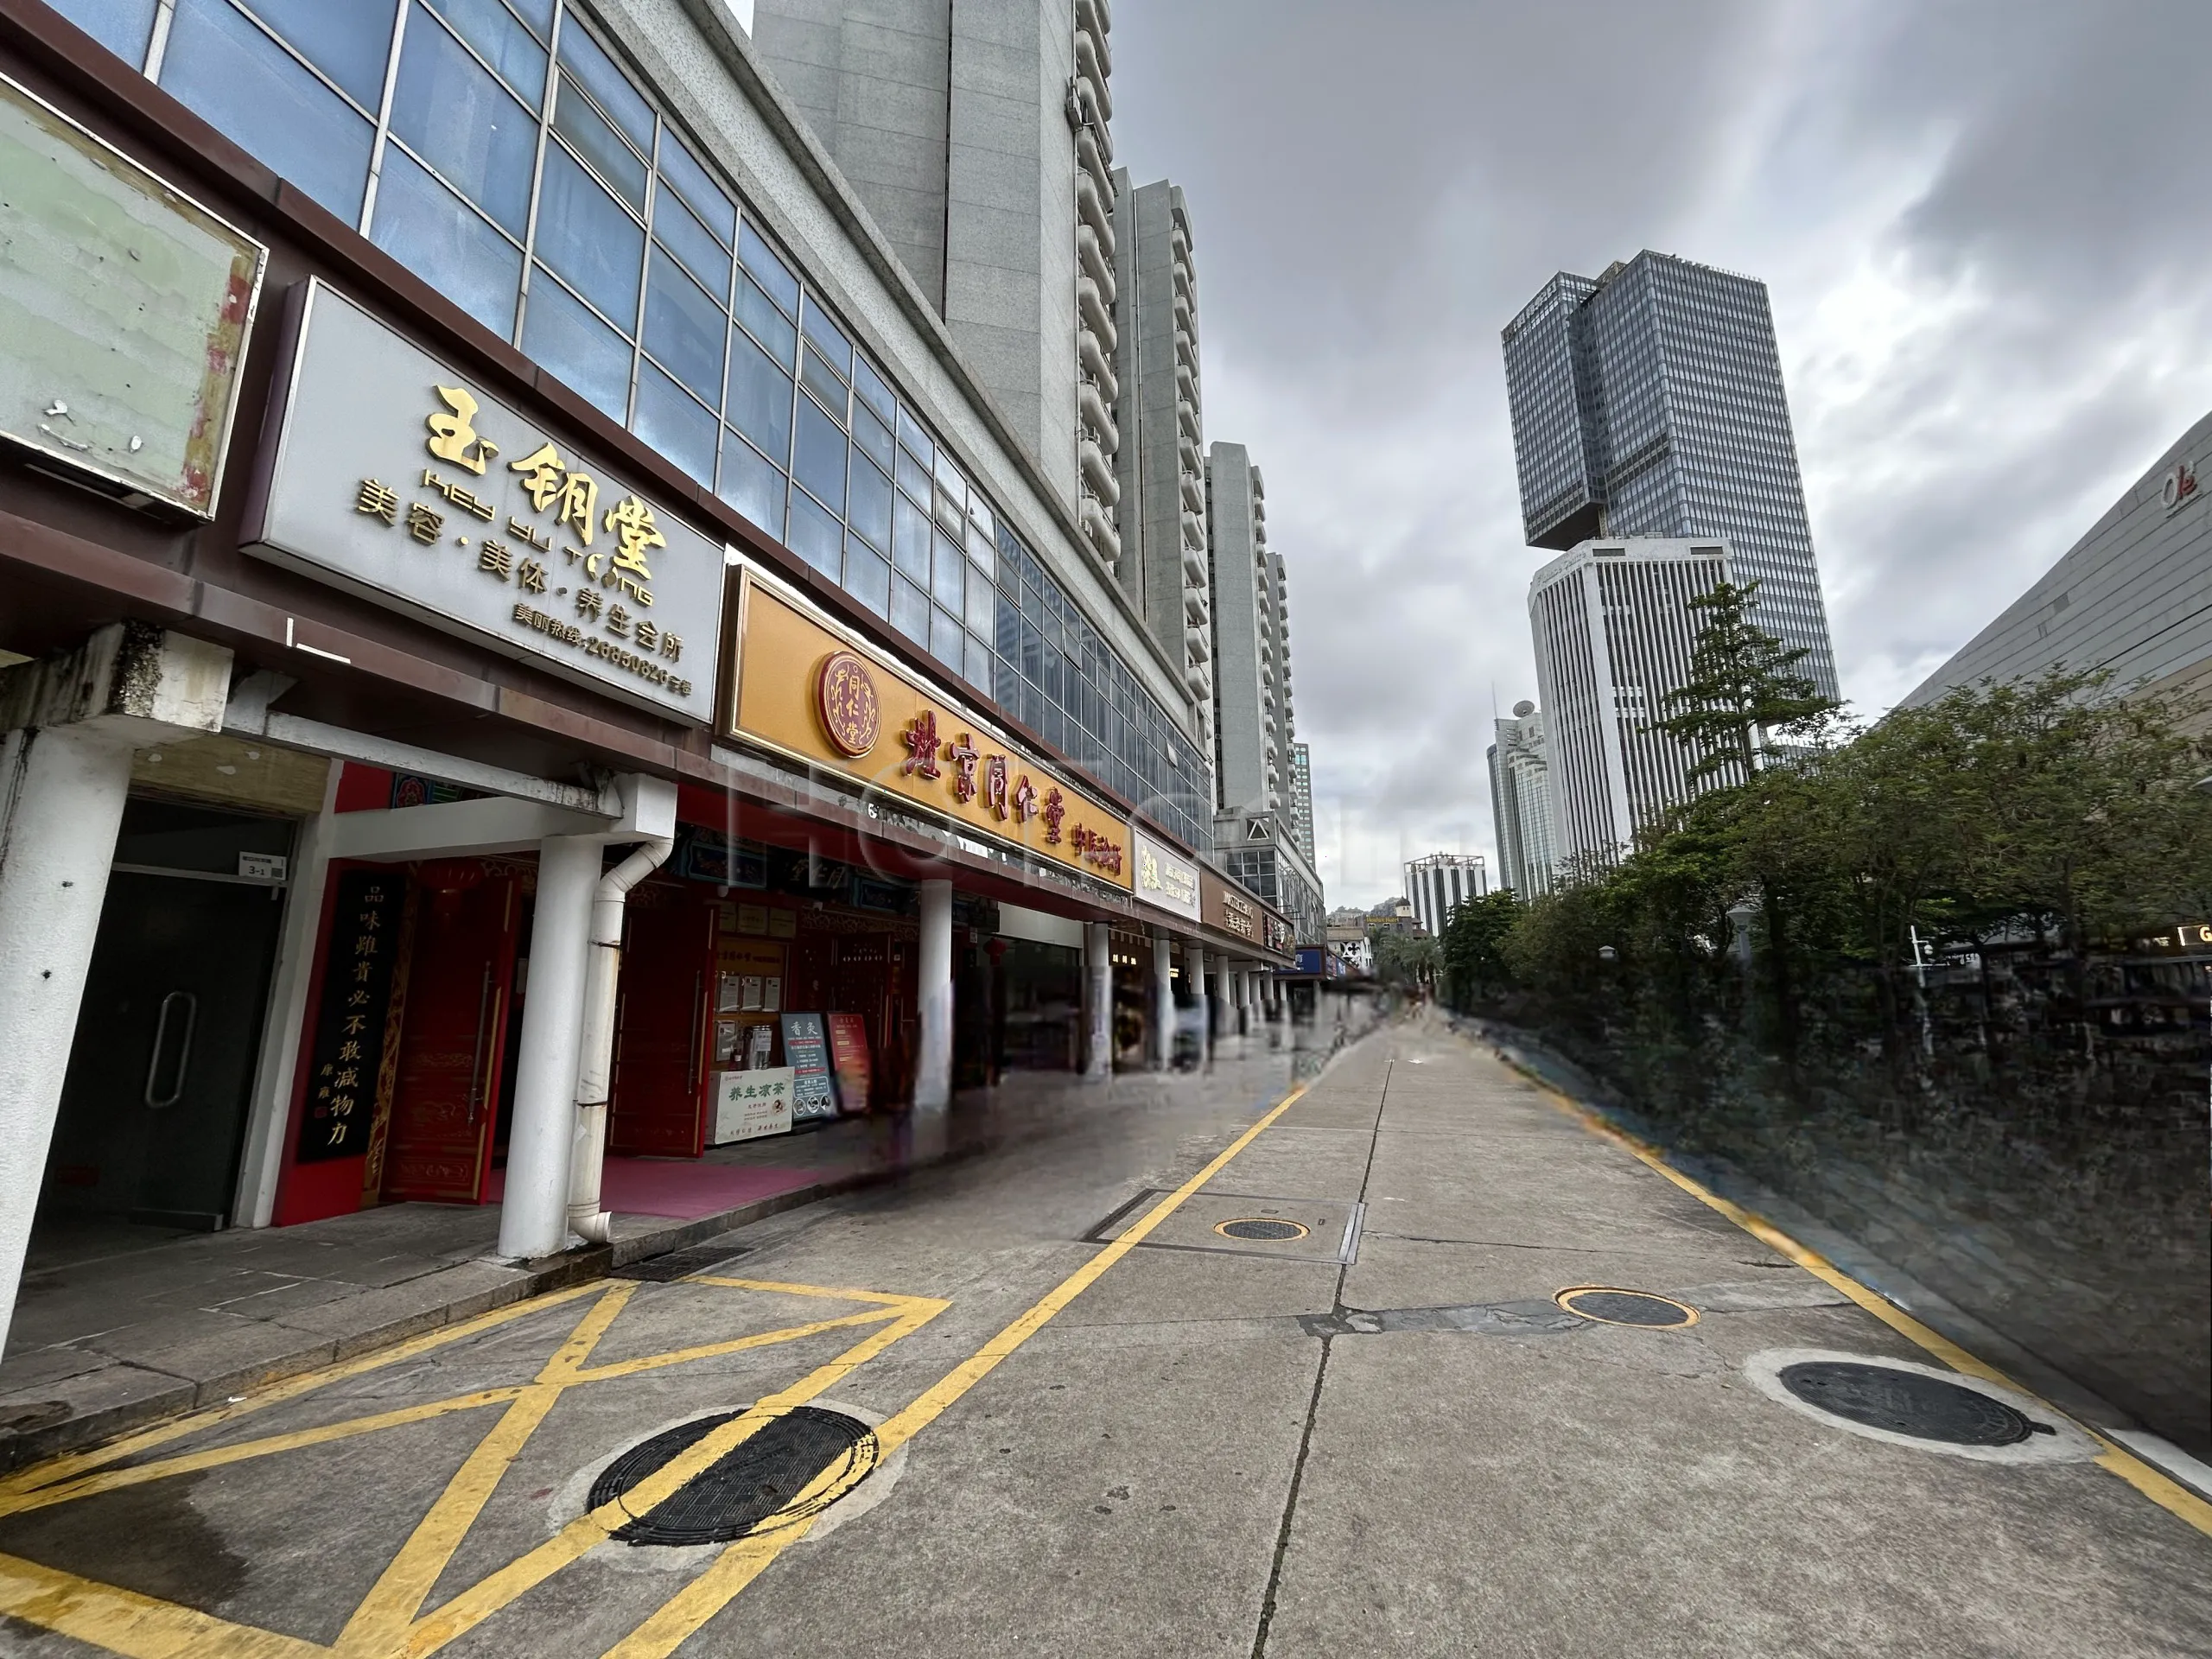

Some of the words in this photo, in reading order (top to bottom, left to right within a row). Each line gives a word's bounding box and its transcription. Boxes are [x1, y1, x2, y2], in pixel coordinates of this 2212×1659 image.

[846, 675, 860, 744] 同仁堂
[249, 865, 264, 875] 3-1
[728, 1082, 785, 1101] 养生凉茶
